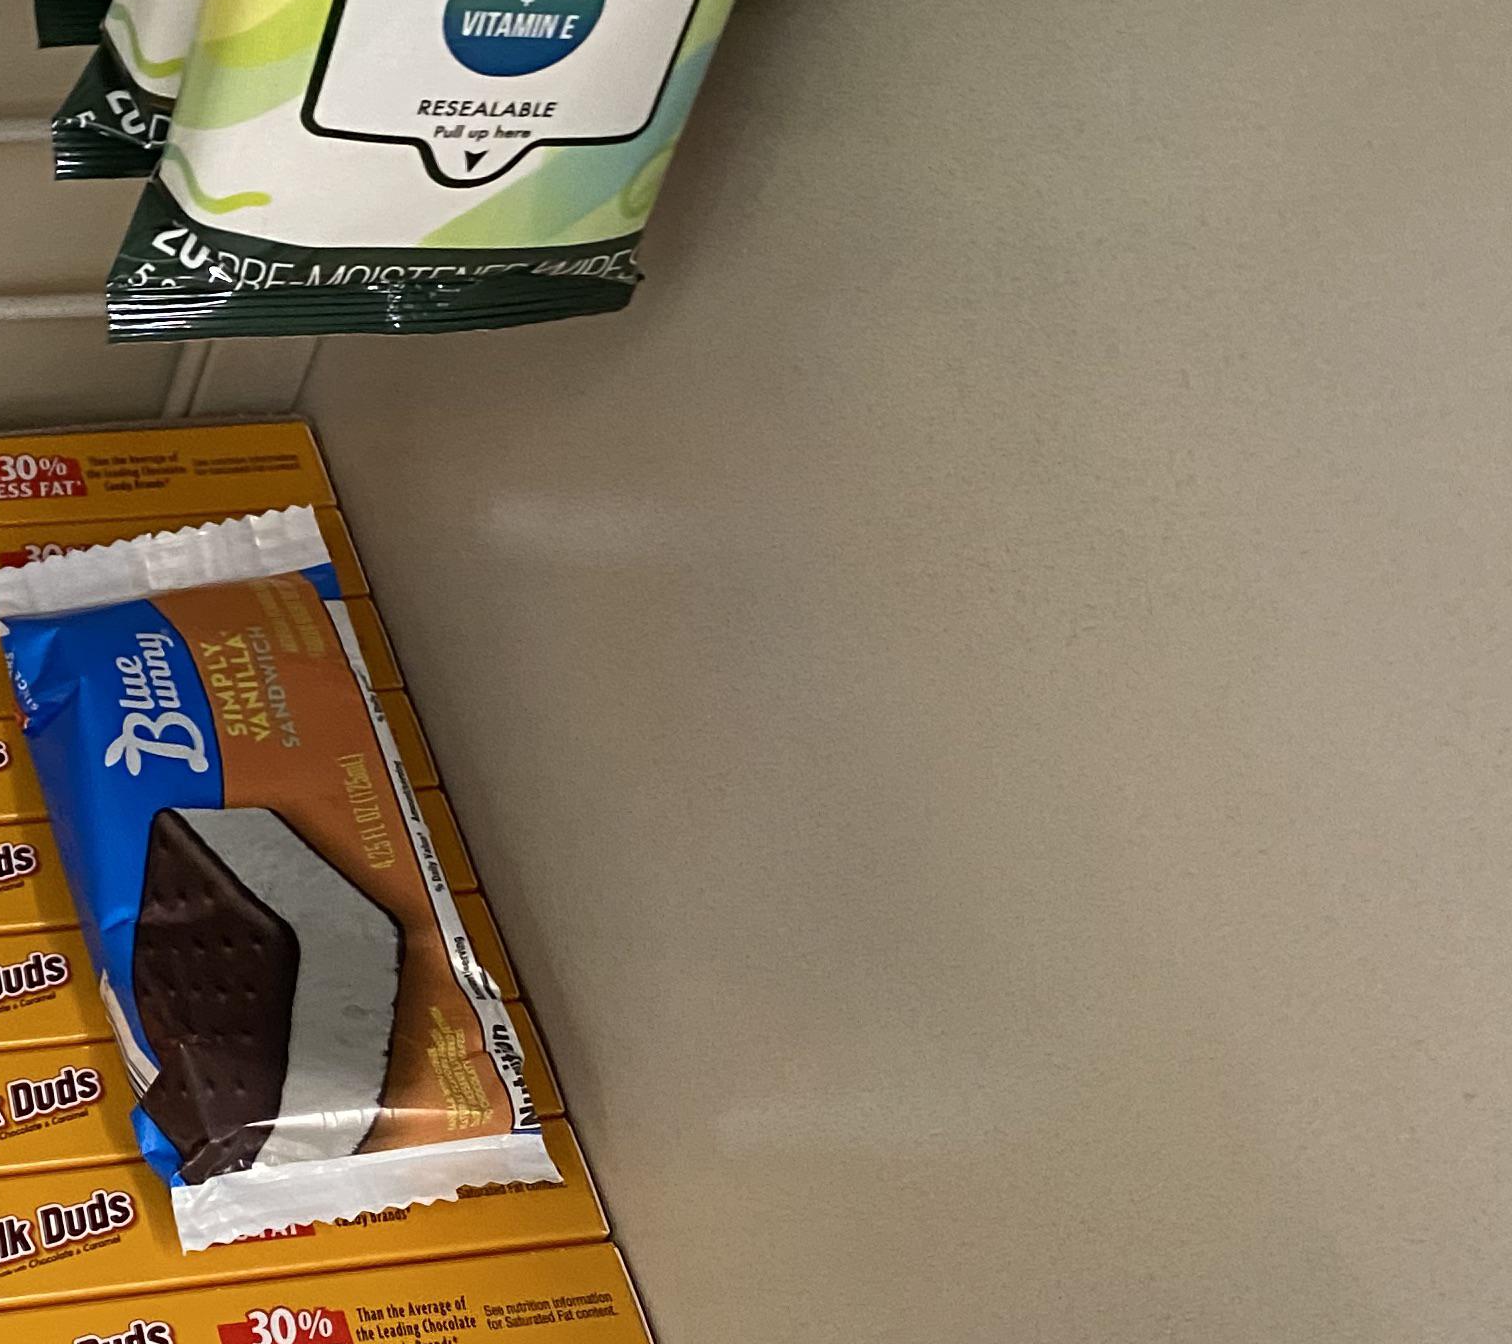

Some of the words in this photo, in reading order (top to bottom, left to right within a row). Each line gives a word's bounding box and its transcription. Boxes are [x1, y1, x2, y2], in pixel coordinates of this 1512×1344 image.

[461, 10, 558, 40] VITAMIN
[558, 14, 580, 40] E
[416, 99, 558, 119] RESEALABLE
[433, 124, 465, 140] Pull
[467, 127, 489, 142] up
[493, 124, 533, 140] here
[200, 641, 249, 737] SIMPLY
[221, 632, 271, 742] VANILLA
[245, 625, 302, 749] SANDWICH
[6, 1065, 102, 1123] Duds
[37, 1189, 135, 1249] Duds
[355, 1305, 385, 1324] Than
[386, 1302, 406, 1320] the
[408, 1298, 452, 1320] Average
[454, 1295, 468, 1312] of
[505, 1298, 552, 1316] nutrition
[552, 1290, 614, 1312] information
[355, 1325, 376, 1343] the
[376, 1320, 421, 1342] Leading
[422, 1314, 478, 1335] Chocolate
[504, 1311, 556, 1330] Saturated
[556, 1308, 576, 1324] Fat
